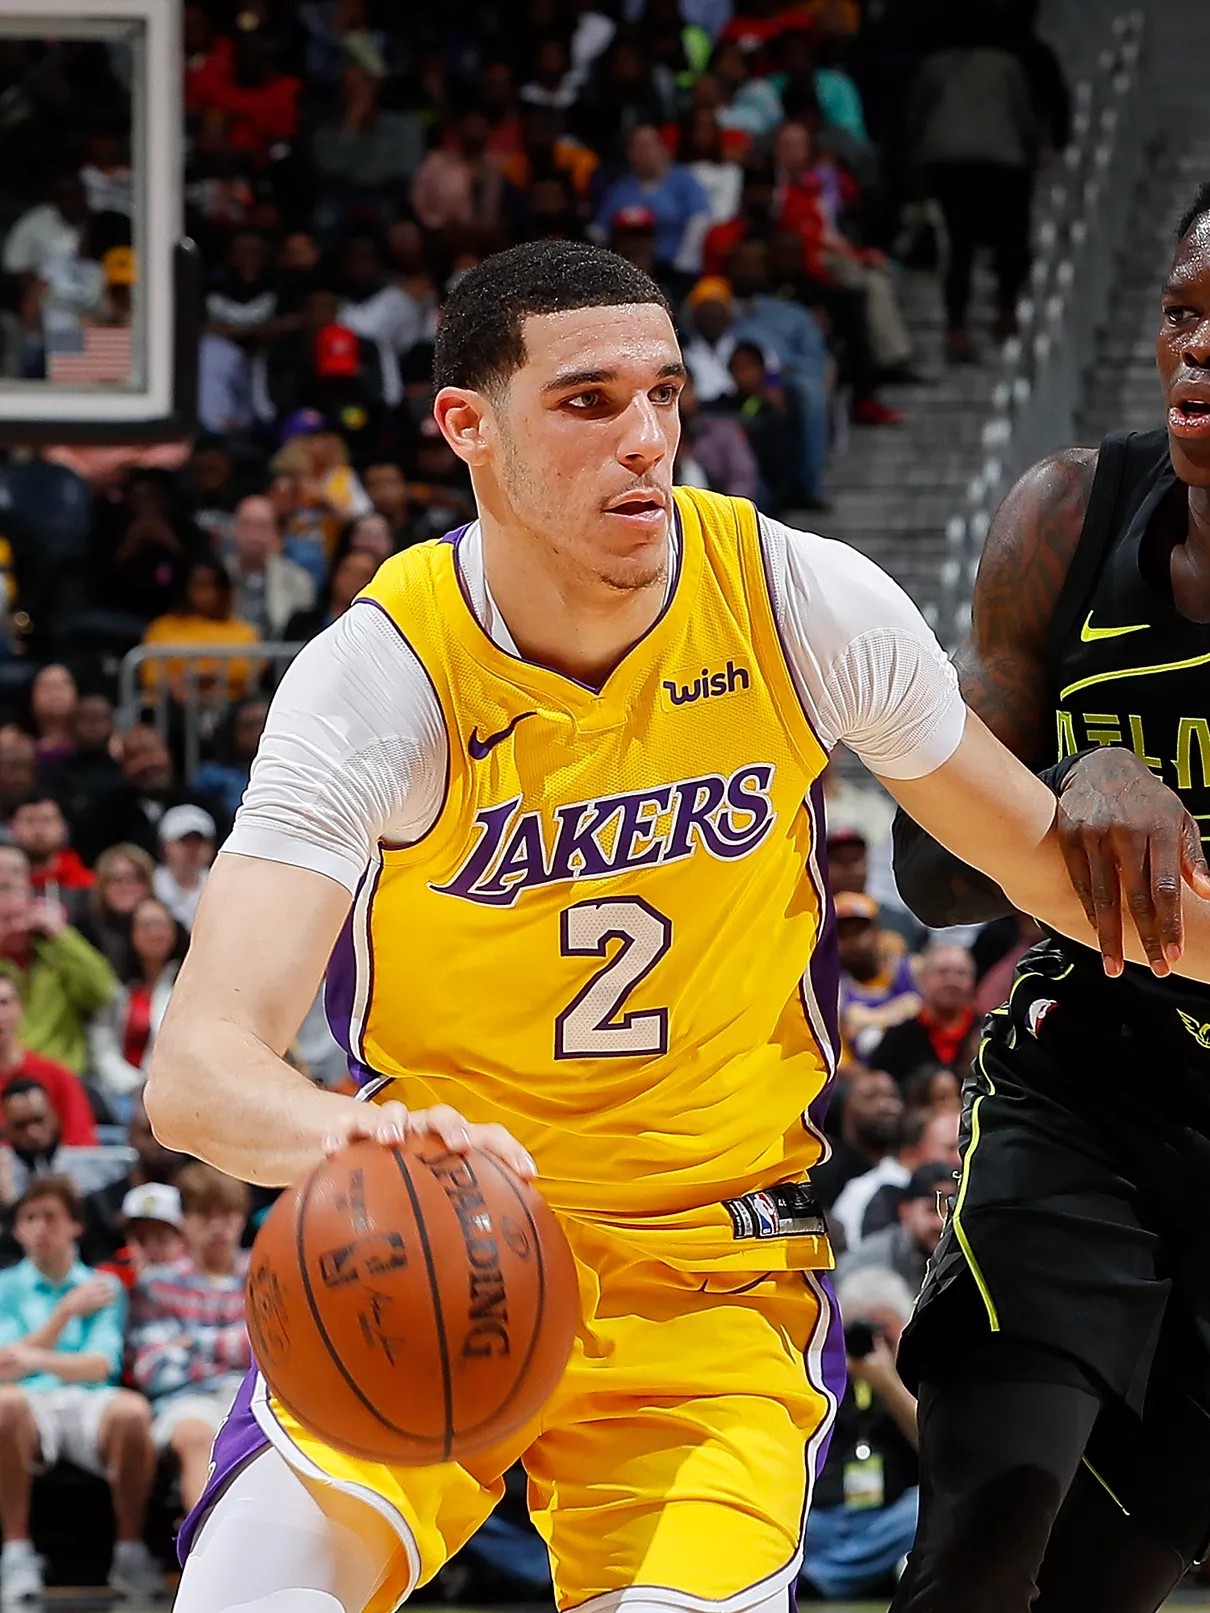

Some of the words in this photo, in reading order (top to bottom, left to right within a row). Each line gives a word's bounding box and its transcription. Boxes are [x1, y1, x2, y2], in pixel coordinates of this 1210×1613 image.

[663, 661, 749, 705] wish
[426, 762, 777, 908] LAKERS
[554, 895, 672, 1060] 2
